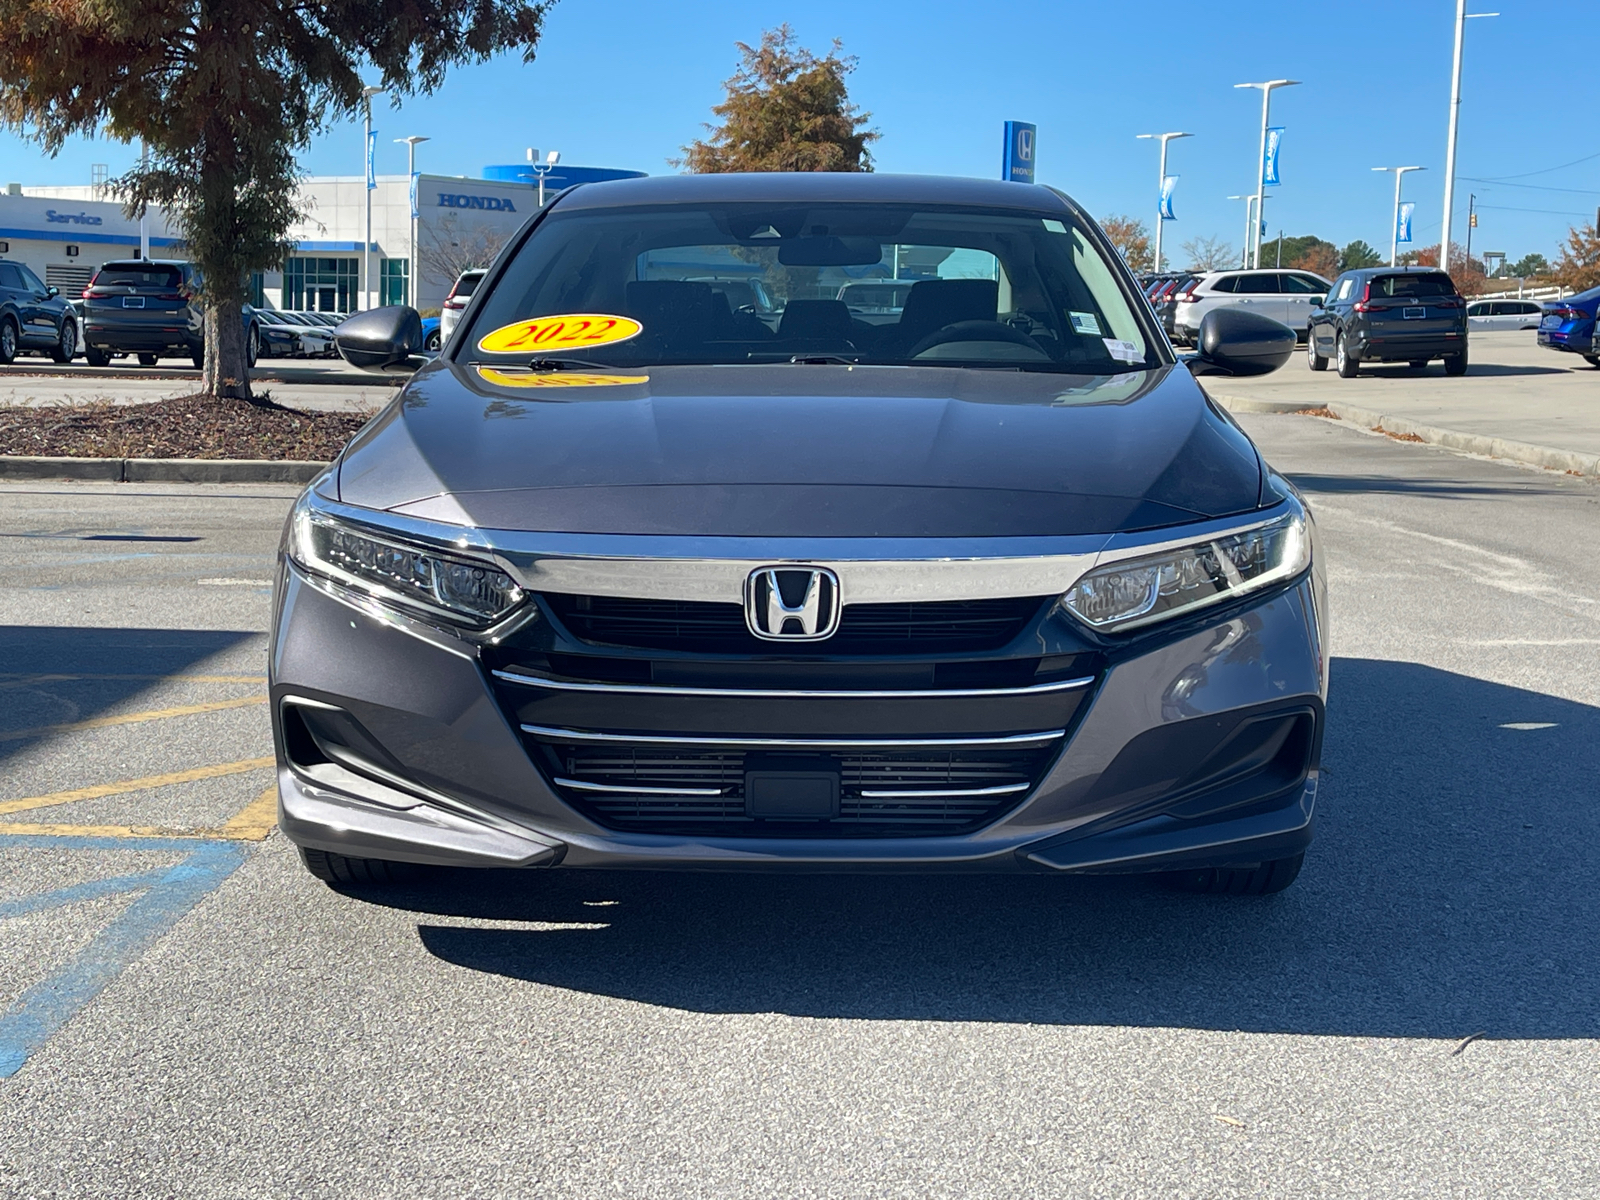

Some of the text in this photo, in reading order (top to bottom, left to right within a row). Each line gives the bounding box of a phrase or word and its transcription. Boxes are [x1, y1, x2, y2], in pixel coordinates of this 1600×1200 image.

[1012, 166, 1033, 177] HOND
[437, 193, 517, 212] HONDA
[46, 209, 103, 226] Service
[503, 320, 617, 348] 2022
